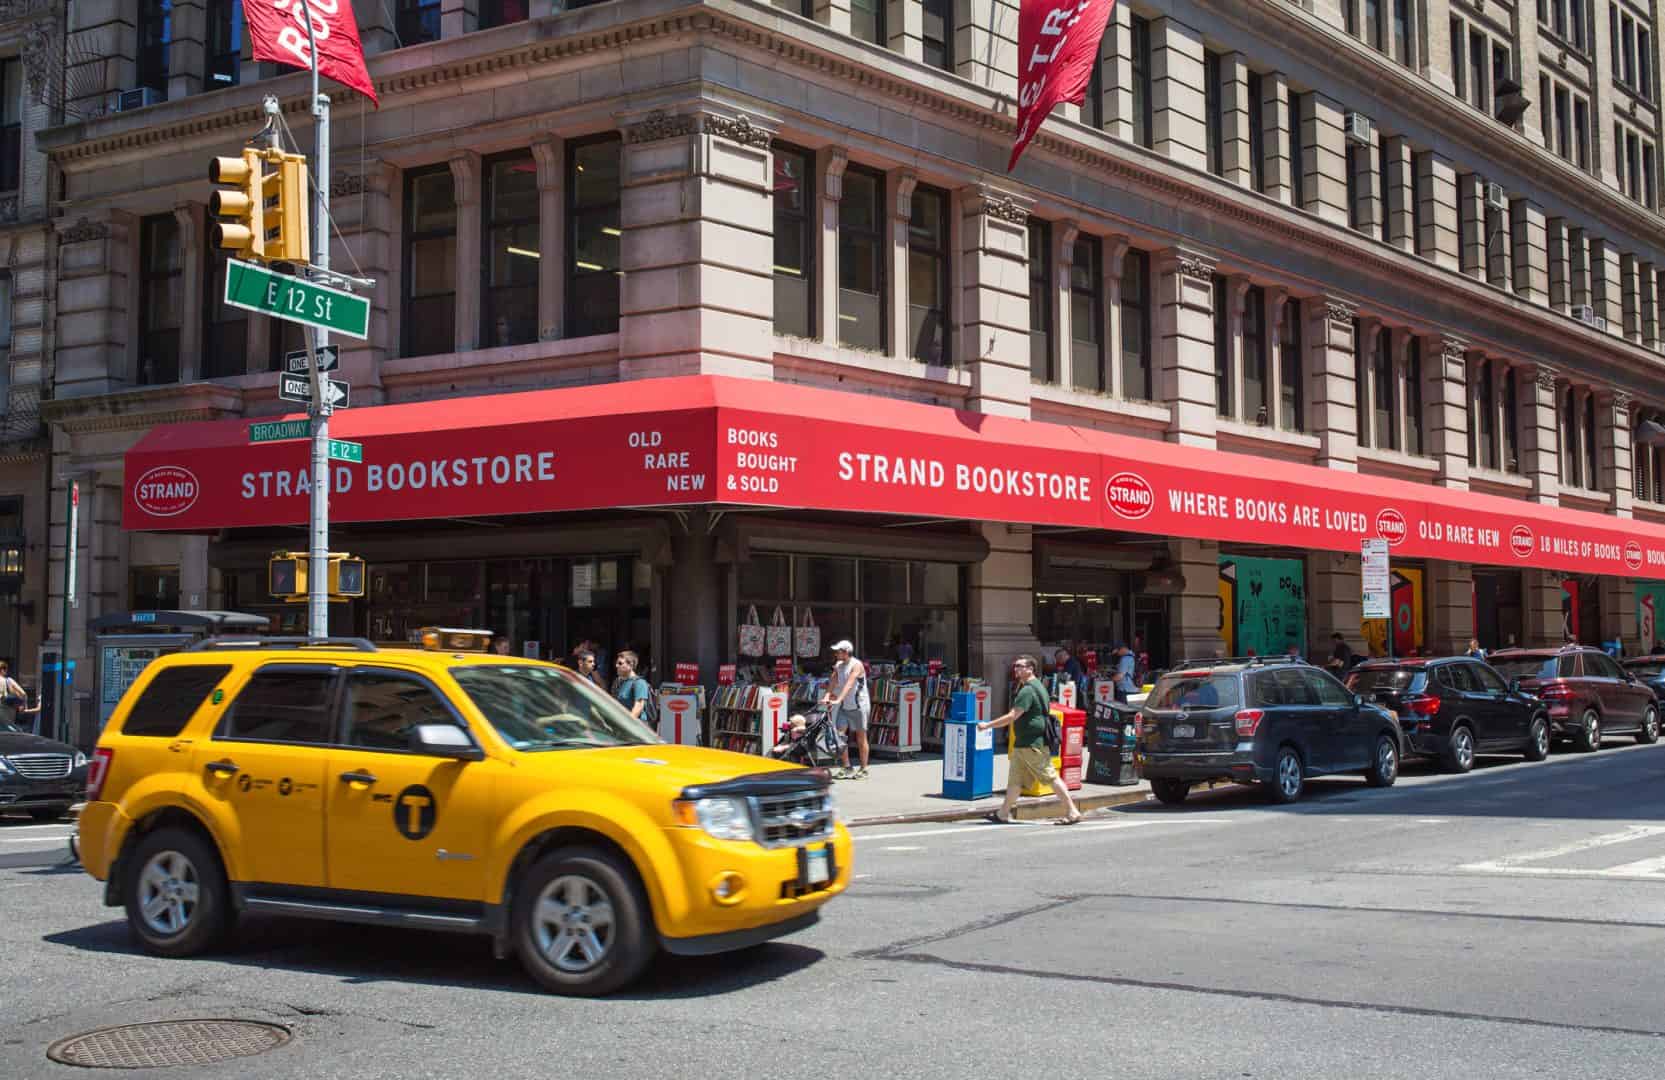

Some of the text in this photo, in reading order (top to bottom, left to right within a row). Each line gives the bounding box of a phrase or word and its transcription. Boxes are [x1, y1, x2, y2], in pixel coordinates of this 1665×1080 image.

[267, 281, 334, 321] E 12 St
[291, 358, 306, 370] ONE
[287, 382, 307, 394] ONE
[253, 421, 306, 441] BROADWAY
[628, 431, 662, 448] OLD
[727, 428, 778, 448] BOOKS
[331, 442, 337, 457] E
[341, 443, 350, 458] 12
[644, 452, 690, 470] RARE
[737, 452, 798, 473] BOUGHT
[241, 451, 556, 499] STRAD BOOKSTORE
[667, 474, 706, 491] NEW
[726, 474, 779, 493] & SOLD
[838, 451, 1092, 502] STRAND BOOKSTORE
[140, 482, 194, 500] STRAND
[1110, 485, 1151, 505] STRAND
[1168, 488, 1368, 534] WHERE BOOKS ARE LOVED
[1378, 519, 1405, 534] STRAND
[1419, 519, 1500, 548] OLD RARE NEW
[1512, 535, 1533, 547] STRAND
[1540, 535, 1621, 561] 18 MILES OF BOOKS
[402, 795, 430, 833] T
